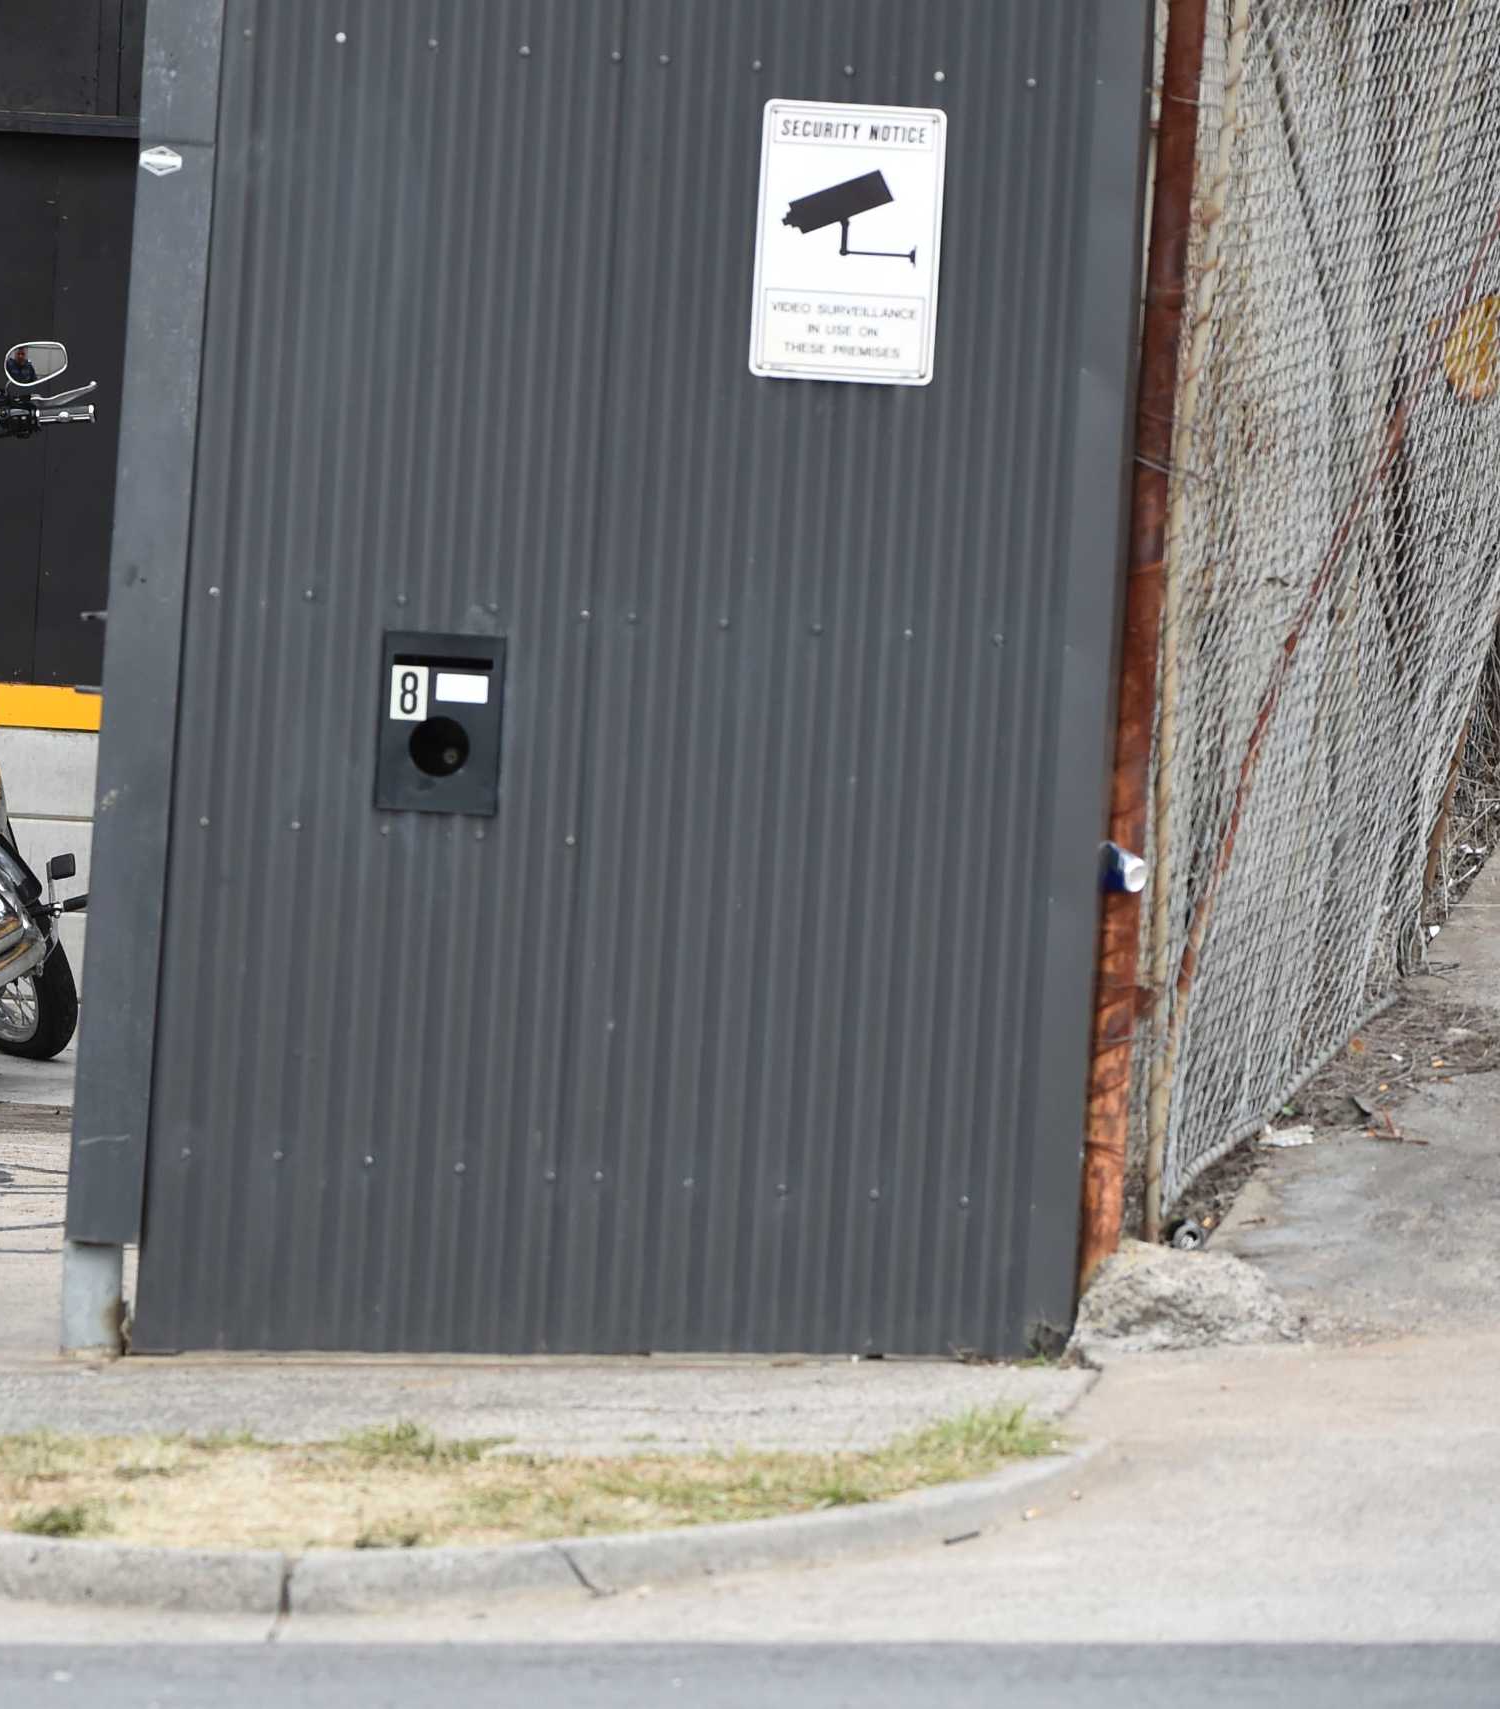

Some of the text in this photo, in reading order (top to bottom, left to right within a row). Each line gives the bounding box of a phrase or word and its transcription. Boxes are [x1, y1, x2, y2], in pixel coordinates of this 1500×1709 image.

[781, 119, 926, 144] SECURITY NOTICE
[772, 301, 917, 320] VIDEO SURVEILLANCE
[807, 324, 878, 337] IN USE ON
[784, 341, 900, 359] THESE PREMISES
[400, 671, 418, 715] 8
